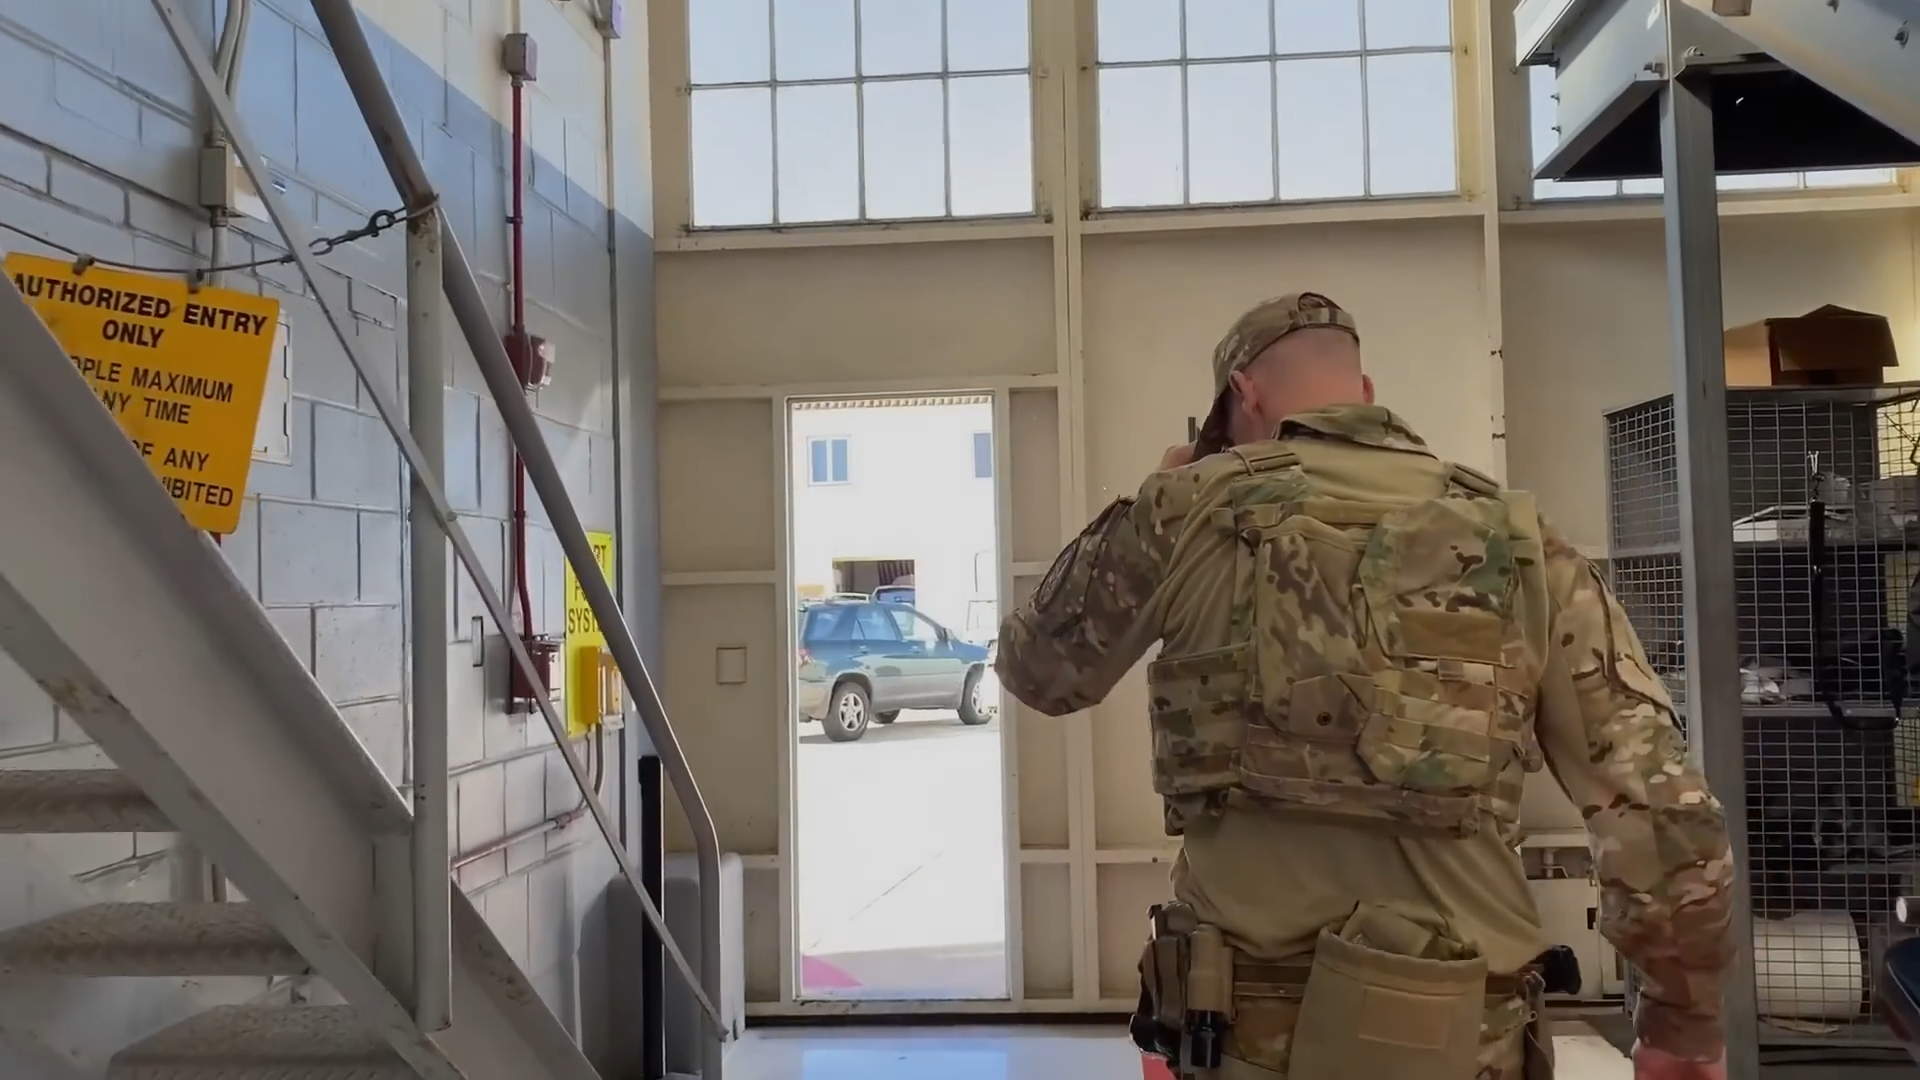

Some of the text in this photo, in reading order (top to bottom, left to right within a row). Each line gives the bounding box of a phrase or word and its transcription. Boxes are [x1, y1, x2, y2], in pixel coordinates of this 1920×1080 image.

[15, 272, 268, 336] AUTHORIZED ENTRY
[102, 319, 164, 348] ONLY
[131, 366, 233, 403] MAXIMUM
[94, 388, 191, 424] NY TIME
[163, 447, 209, 472] ANY
[162, 476, 233, 507] IBITED
